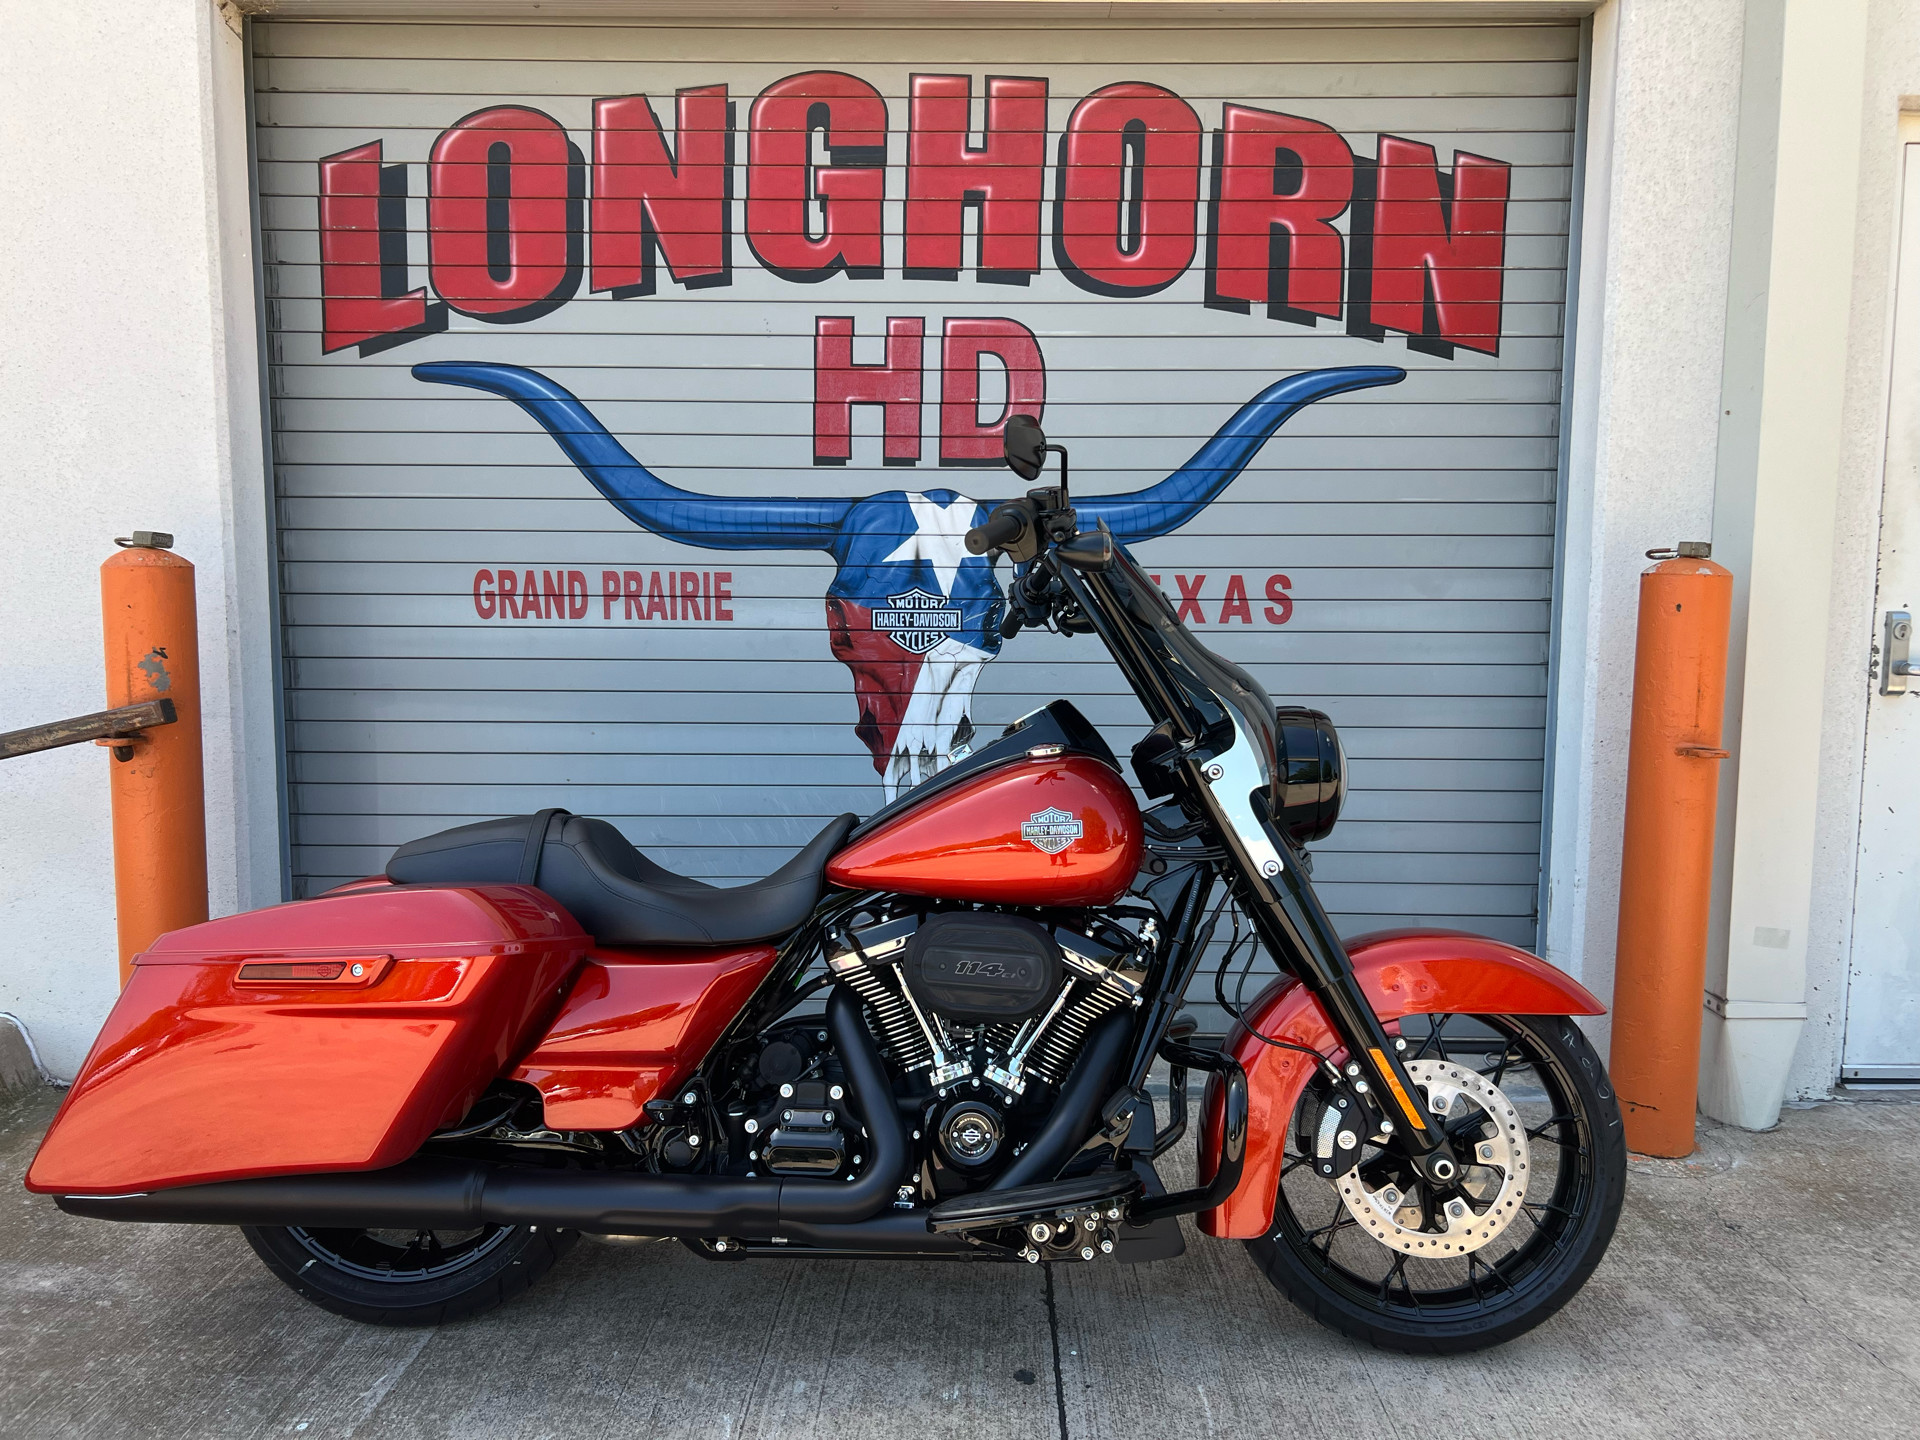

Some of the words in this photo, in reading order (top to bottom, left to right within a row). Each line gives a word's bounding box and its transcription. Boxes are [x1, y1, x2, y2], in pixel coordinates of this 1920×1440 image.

[319, 70, 1512, 360] LONGHORN
[813, 316, 1046, 467] HD
[473, 568, 588, 620] GRAND
[602, 570, 734, 622] PRAIRIE
[1149, 574, 1293, 625] XAS
[896, 592, 939, 609] MOTOR
[877, 612, 957, 627] HARLEY-DAVIDSON
[896, 632, 939, 651] CYCLES
[1038, 811, 1066, 823] MOTOR
[1026, 825, 1078, 836] HARLEY-DAVIDSON
[955, 960, 1005, 977] 114
